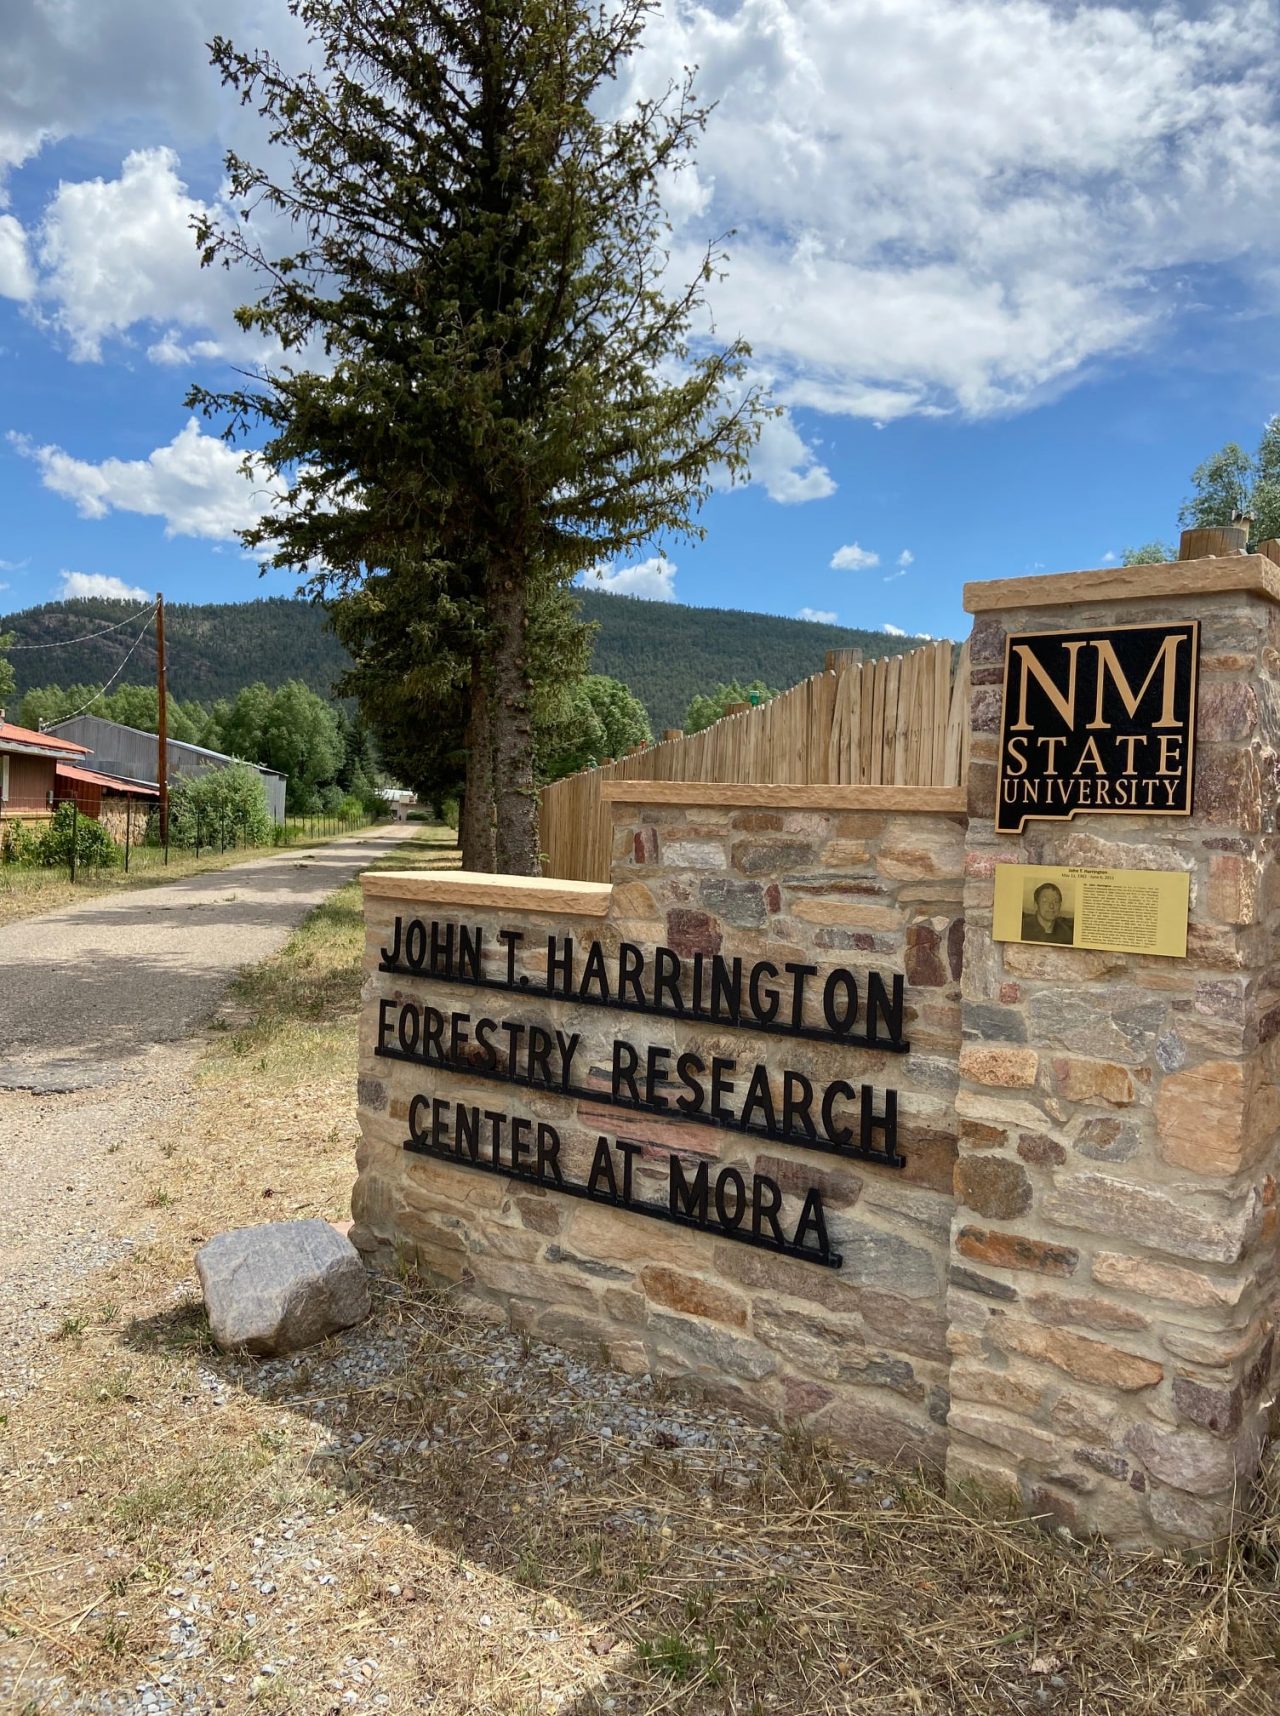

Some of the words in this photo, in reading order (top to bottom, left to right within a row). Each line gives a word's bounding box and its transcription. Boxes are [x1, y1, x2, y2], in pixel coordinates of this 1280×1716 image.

[1010, 634, 1188, 732] NM
[1003, 778, 1180, 806] UNIVERSITY
[1006, 735, 1184, 777] STATE
[380, 916, 483, 984] JOHN
[499, 930, 530, 986] T.
[547, 935, 905, 1044] HARRINGTON
[377, 998, 581, 1093] FORESTRY
[611, 1039, 899, 1160] RESEARCH
[408, 1094, 563, 1186] CENTER
[587, 1136, 643, 1203] AT
[669, 1154, 832, 1256] MORA
